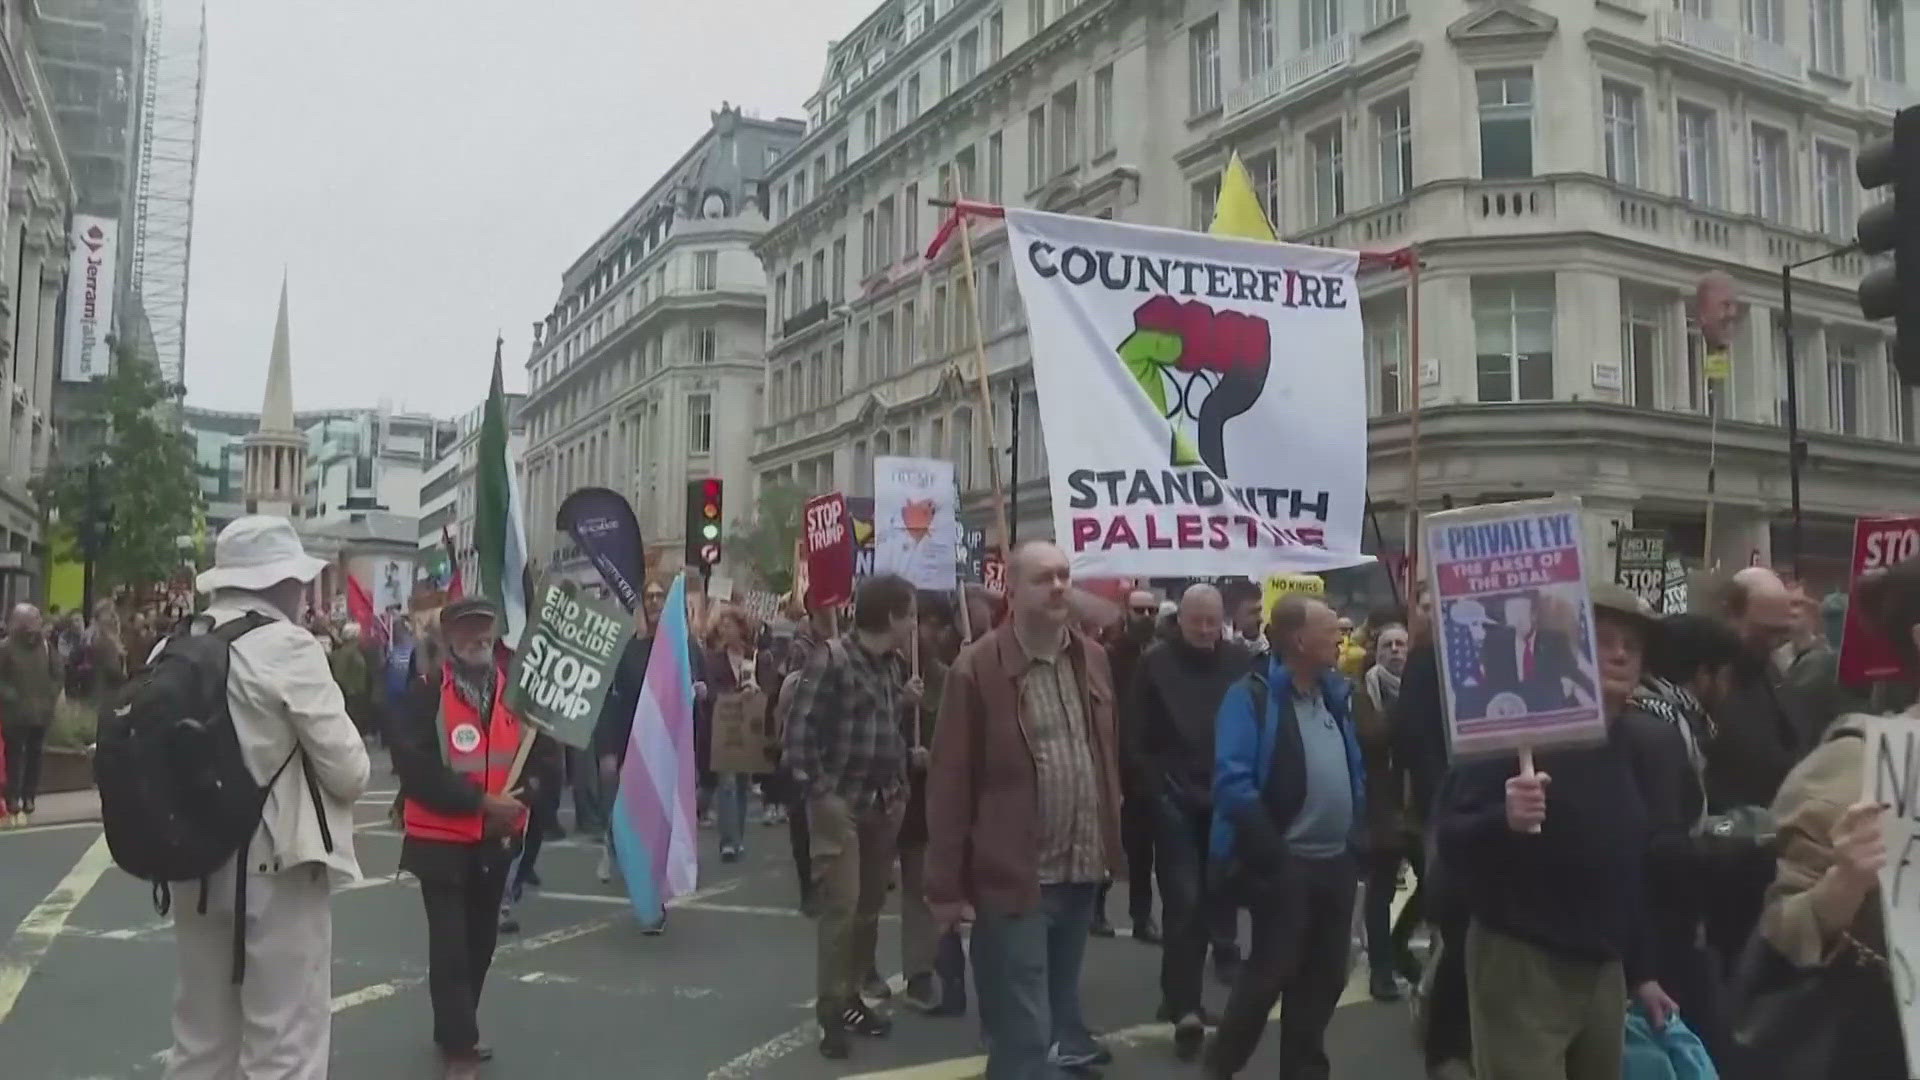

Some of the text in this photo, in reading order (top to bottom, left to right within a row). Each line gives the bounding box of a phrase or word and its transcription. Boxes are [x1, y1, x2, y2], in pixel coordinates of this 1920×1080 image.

[1028, 240, 1347, 309] COUNTERFIRE
[1068, 469, 1224, 508] STAND
[807, 500, 842, 533] STOP
[808, 523, 845, 553] TRUMP
[1448, 513, 1574, 559] PRIVATE EYE
[1863, 528, 1920, 566] STO
[1272, 578, 1287, 590] NO
[1452, 561, 1484, 578] THE
[1540, 552, 1563, 568] OF
[1468, 569, 1550, 592] THE DEAL
[1620, 569, 1663, 589] STOP
[541, 605, 616, 658] GENOCIDE
[545, 584, 623, 643] END THE
[525, 634, 602, 697] STOP
[519, 661, 591, 721] TRUMP
